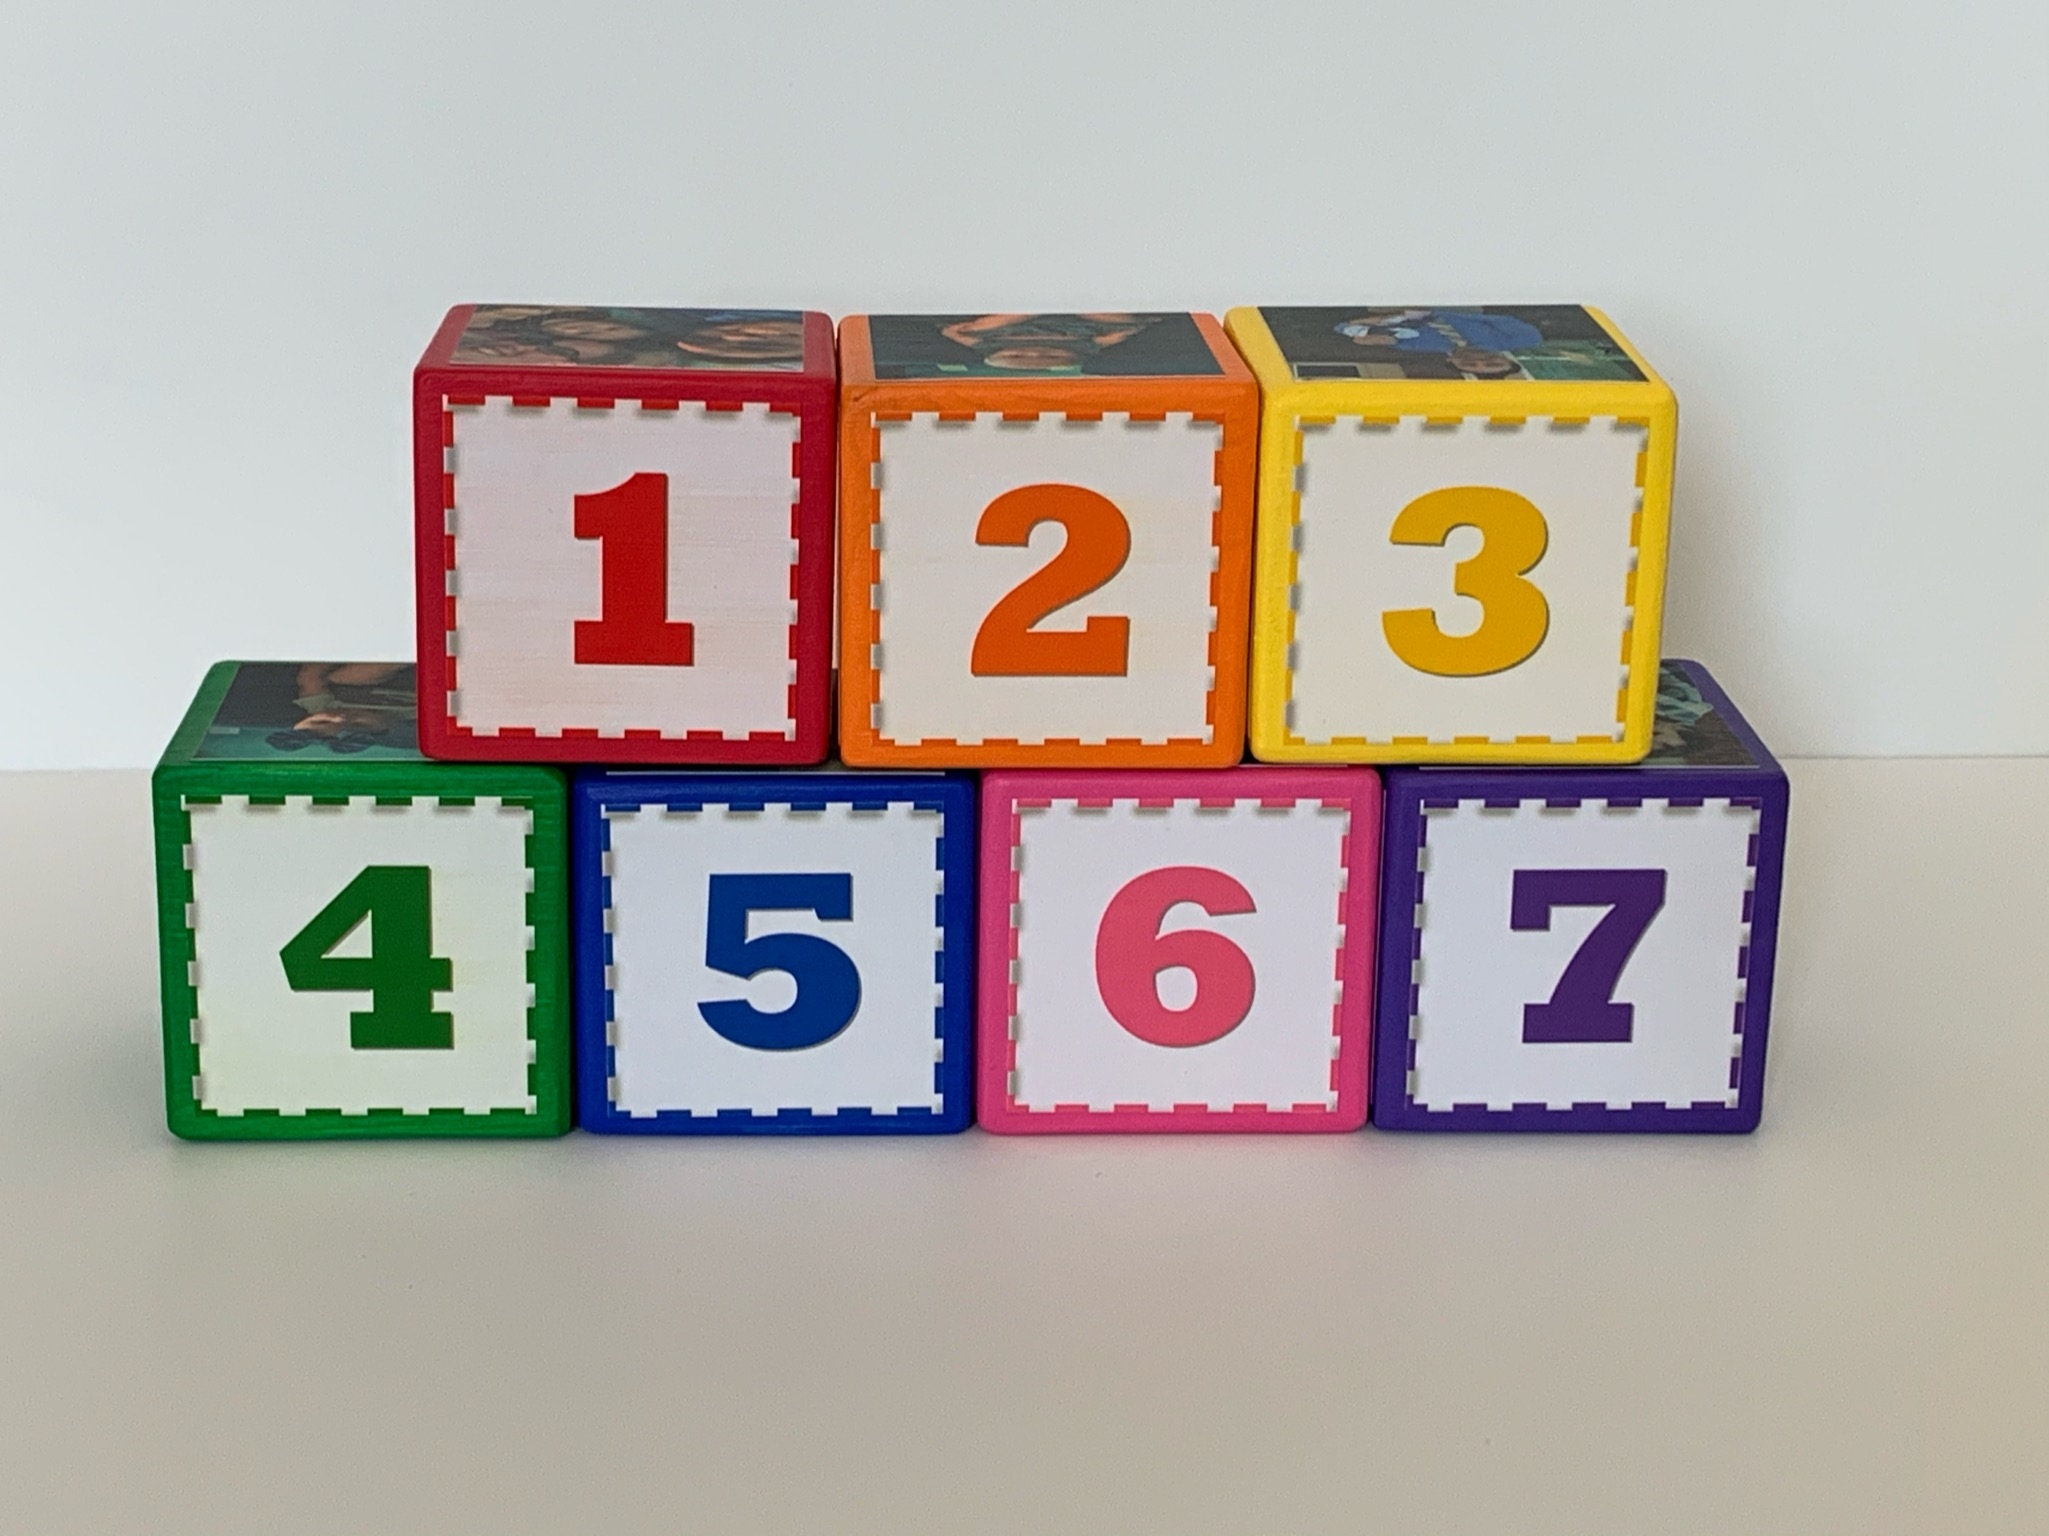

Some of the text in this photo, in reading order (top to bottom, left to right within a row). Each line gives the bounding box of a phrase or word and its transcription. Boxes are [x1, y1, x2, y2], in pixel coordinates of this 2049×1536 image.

[574, 473, 694, 666] 1
[971, 484, 1131, 676] 2
[1382, 487, 1549, 677] 3
[280, 866, 453, 1048] 4
[698, 873, 861, 1049] 5
[1096, 867, 1255, 1046] 6
[1511, 869, 1666, 1042] 7
